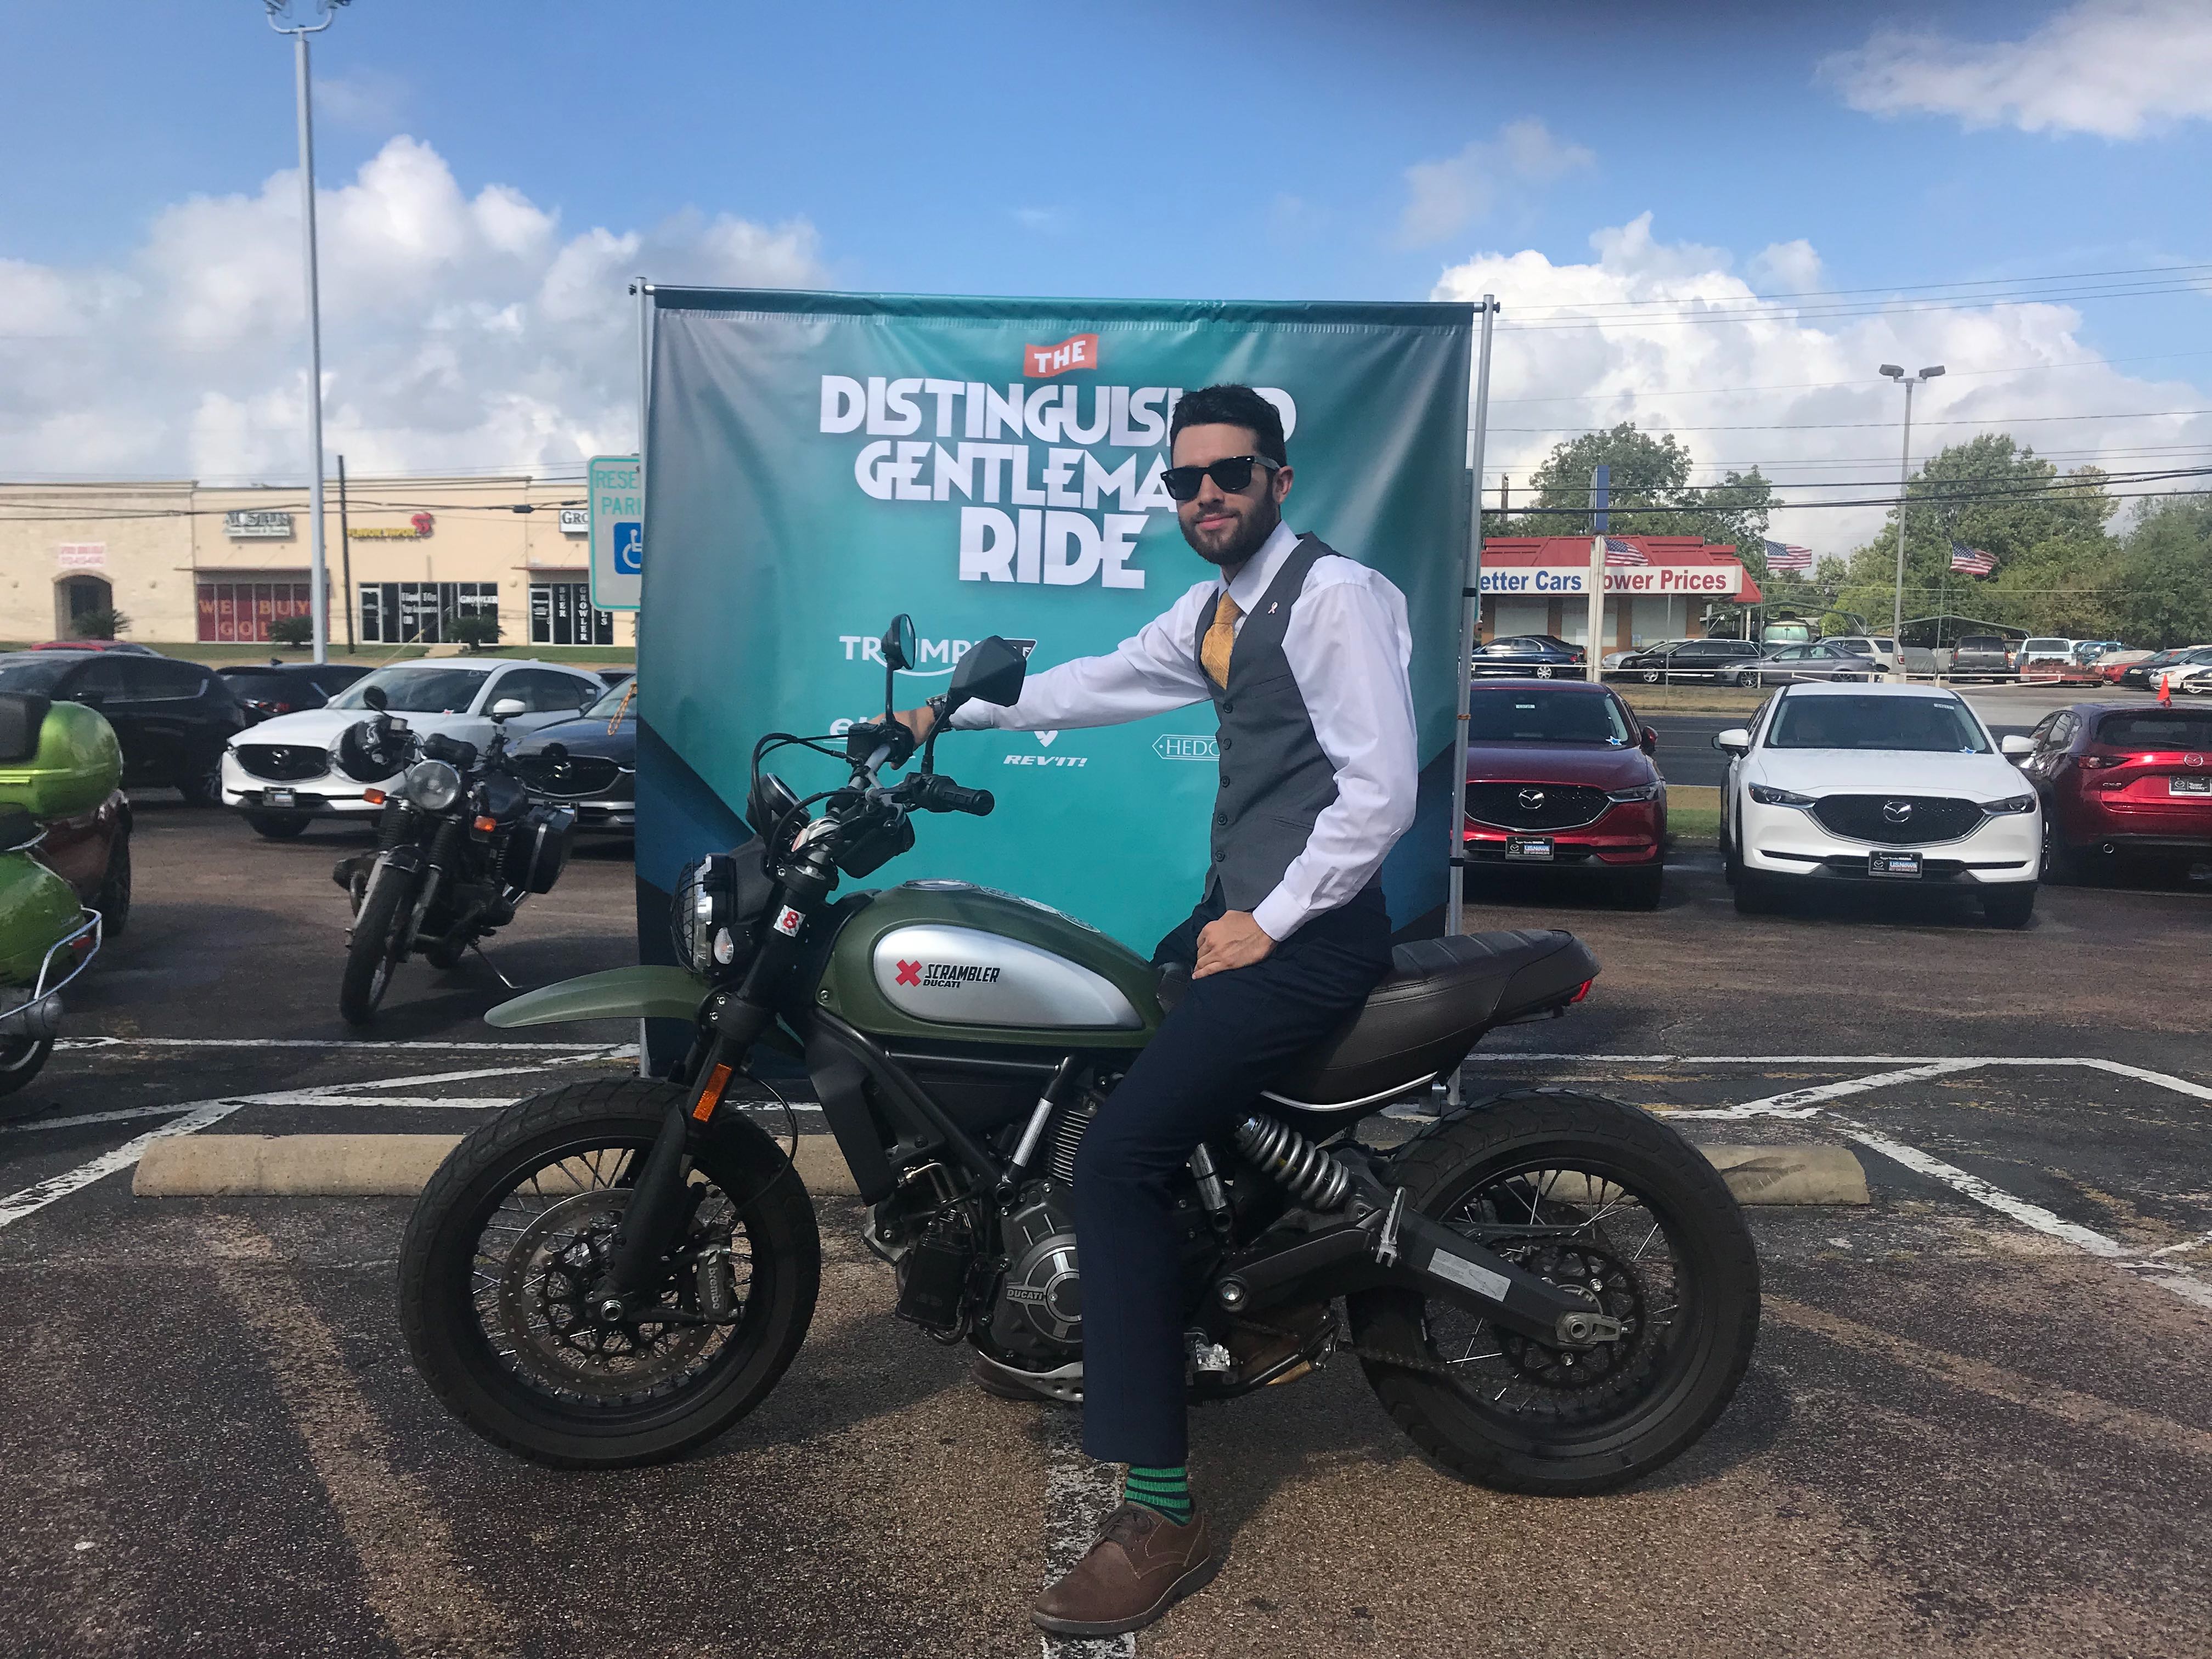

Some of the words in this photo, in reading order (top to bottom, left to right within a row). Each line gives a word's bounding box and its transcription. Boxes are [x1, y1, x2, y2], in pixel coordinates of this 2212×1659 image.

[1034, 340, 1086, 373] THE
[820, 374, 1296, 447] DISTINGUIS
[595, 470, 638, 489] RESE
[854, 440, 1178, 512] GENTLEMA
[562, 511, 588, 524] GRO
[959, 506, 1150, 589] RIDE
[1481, 571, 1529, 590] etter
[1536, 571, 1582, 591] Cars
[1604, 574, 1654, 590] ower
[1660, 569, 1727, 590] Prices
[199, 599, 234, 614] WE
[259, 600, 309, 615] BUY
[578, 586, 589, 641] GROWLER
[220, 620, 269, 636] GOL
[839, 635, 982, 664] TRMP
[1166, 739, 1221, 757] HEDO
[1003, 755, 1088, 767] REV'IT!
[924, 963, 1001, 983] SCRAMBLER
[923, 979, 961, 989] DUCATI
[708, 1266, 721, 1310] brembo
[1007, 1289, 1043, 1300] DUCATI
